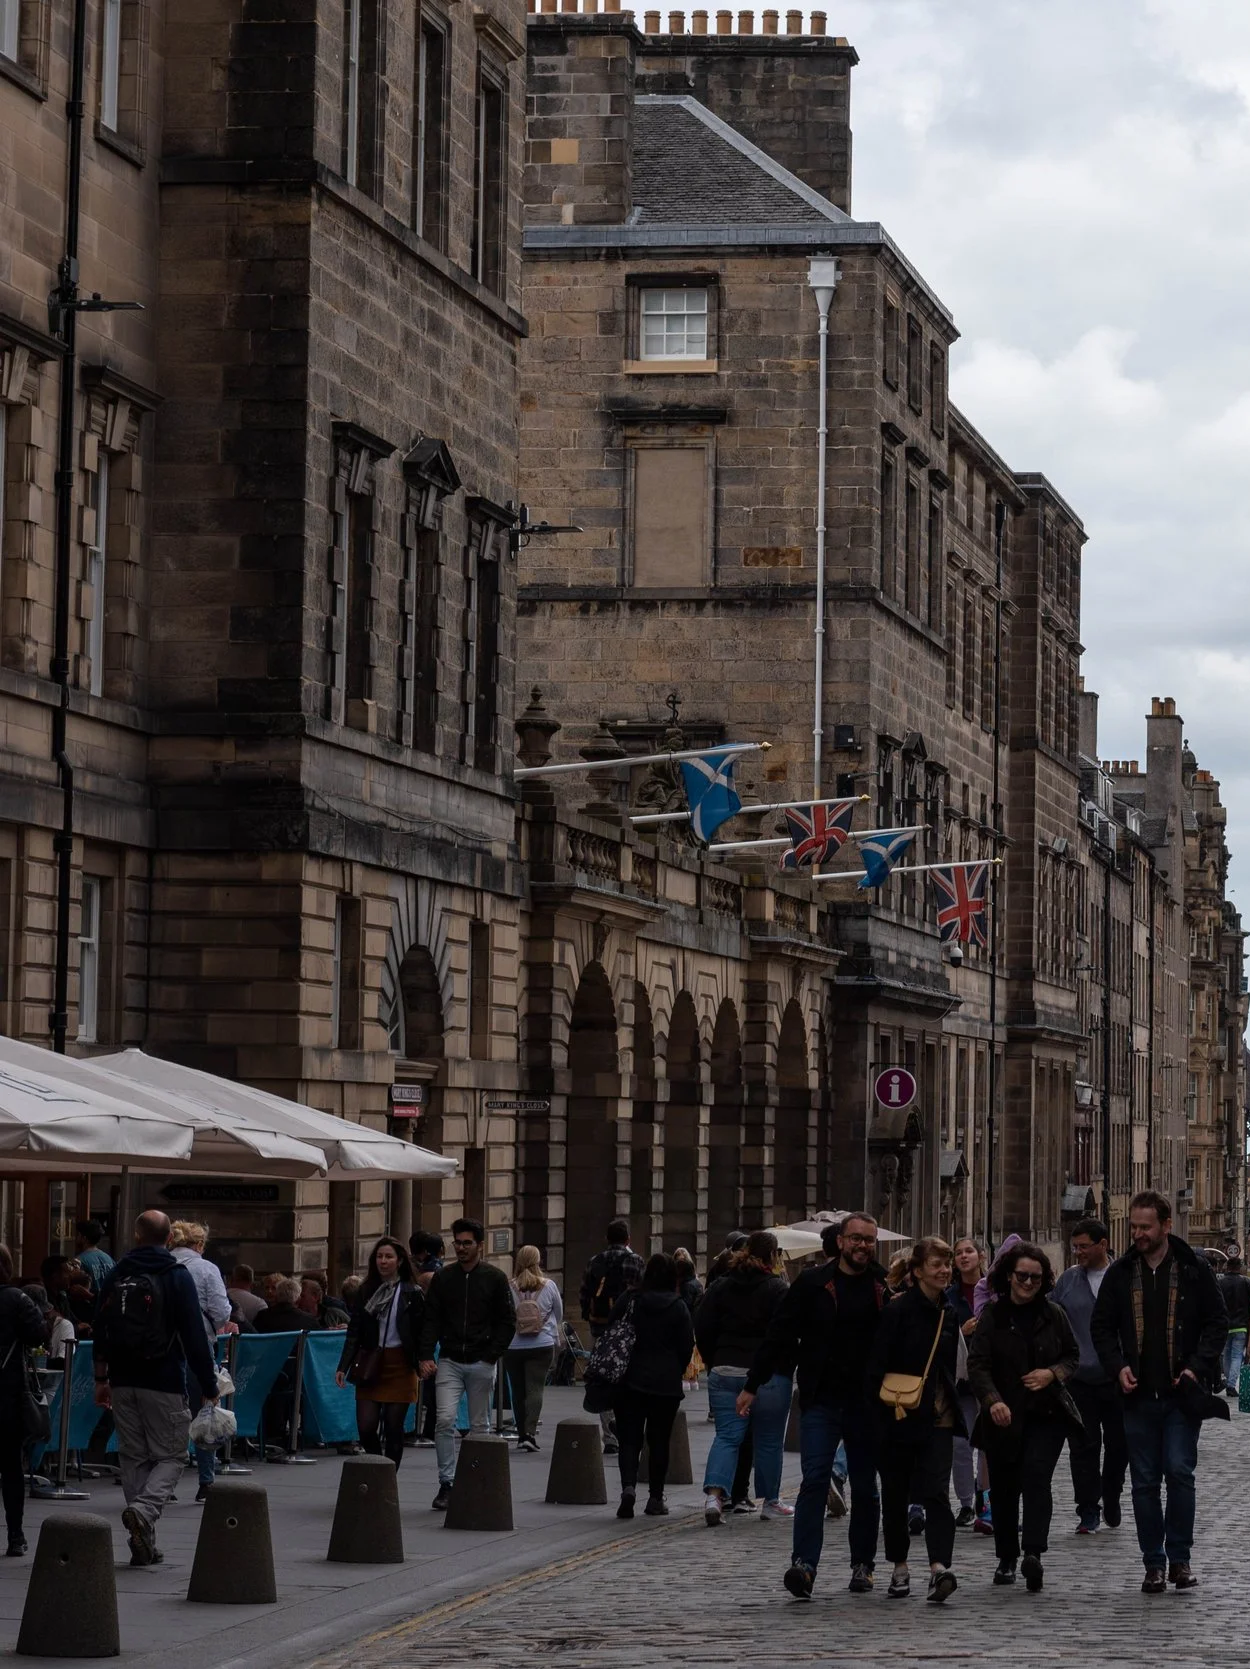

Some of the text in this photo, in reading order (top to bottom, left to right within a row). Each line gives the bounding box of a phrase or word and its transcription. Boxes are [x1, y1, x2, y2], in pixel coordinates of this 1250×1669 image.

[888, 1074, 901, 1103] i
[487, 1101, 504, 1109] MARY
[1228, 1246, 1239, 1255] 20
